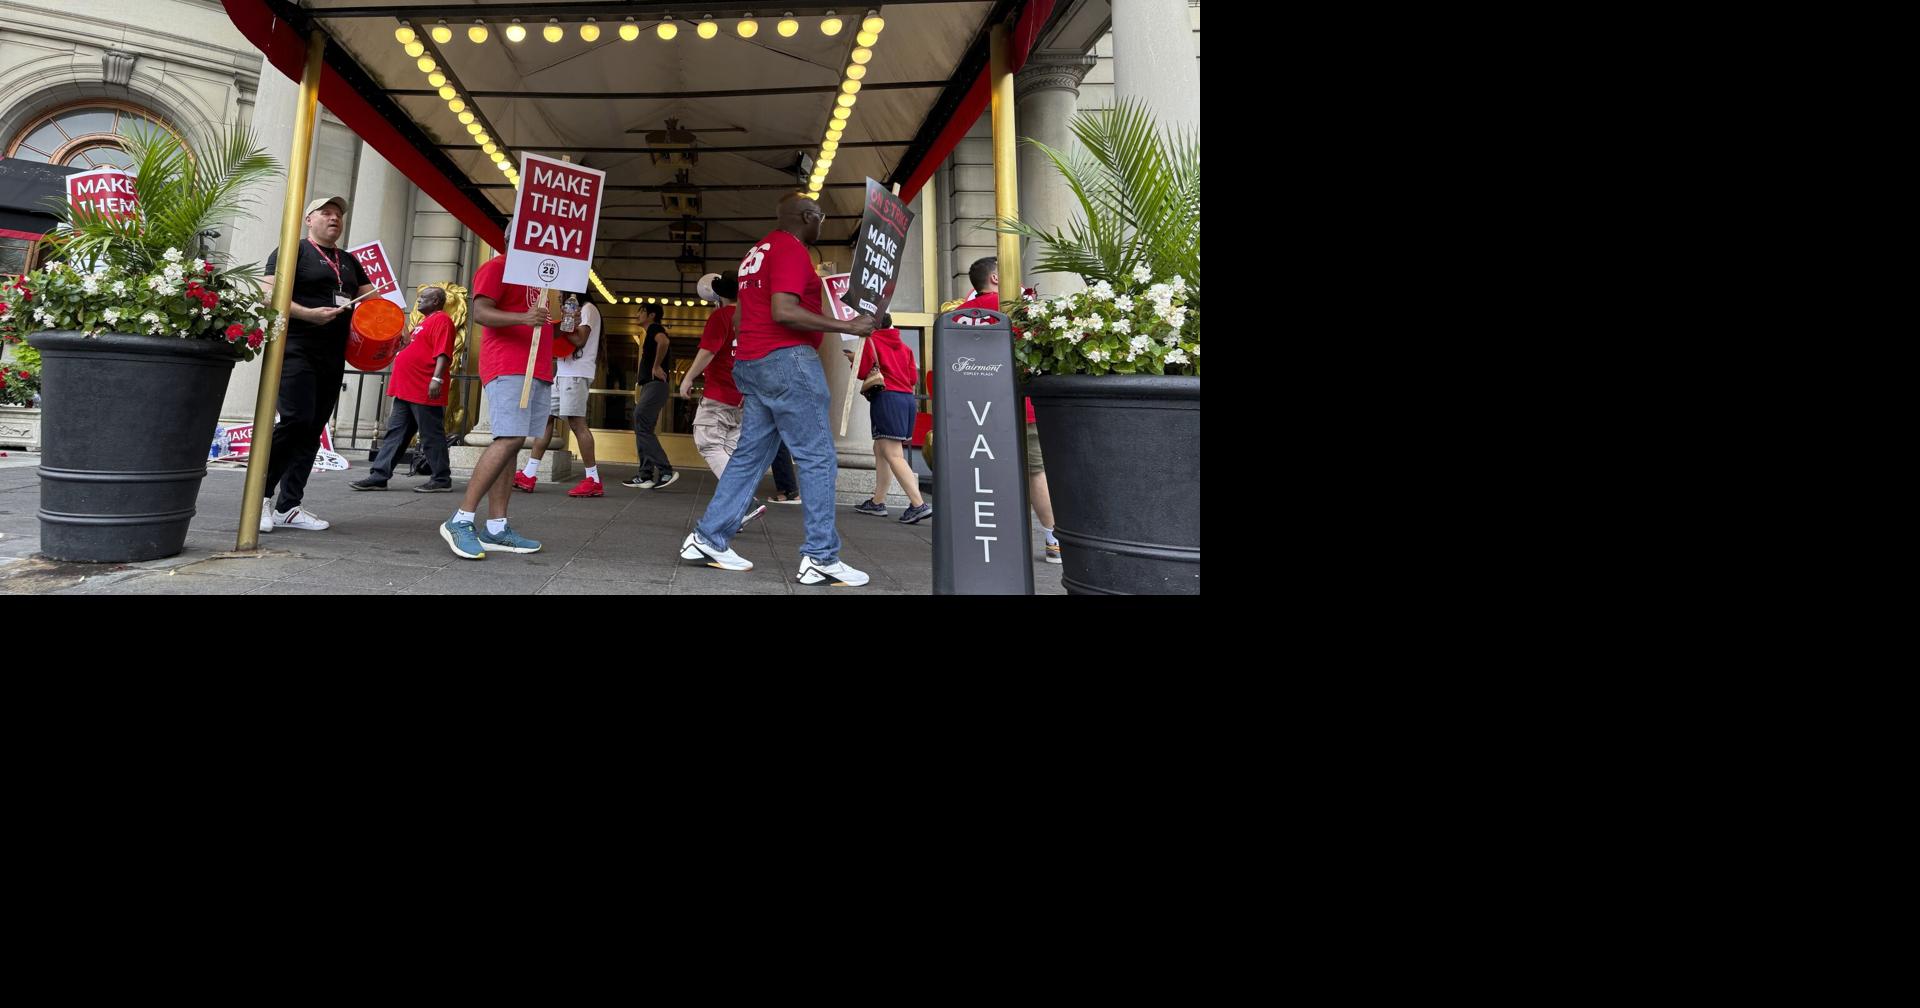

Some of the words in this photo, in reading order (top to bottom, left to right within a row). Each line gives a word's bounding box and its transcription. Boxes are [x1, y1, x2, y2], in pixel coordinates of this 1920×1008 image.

[77, 178, 135, 196] MAKE
[533, 166, 593, 197] MAKE
[79, 198, 136, 215] THEM
[530, 192, 588, 222] THEM
[524, 220, 583, 254] PAY!
[867, 223, 898, 260] MAKE
[356, 248, 377, 262] KE
[864, 244, 894, 280] THEM
[543, 266, 555, 275] 26
[861, 267, 887, 299] PAY.
[952, 357, 1002, 372] Fairmont
[967, 400, 998, 563] VALET
